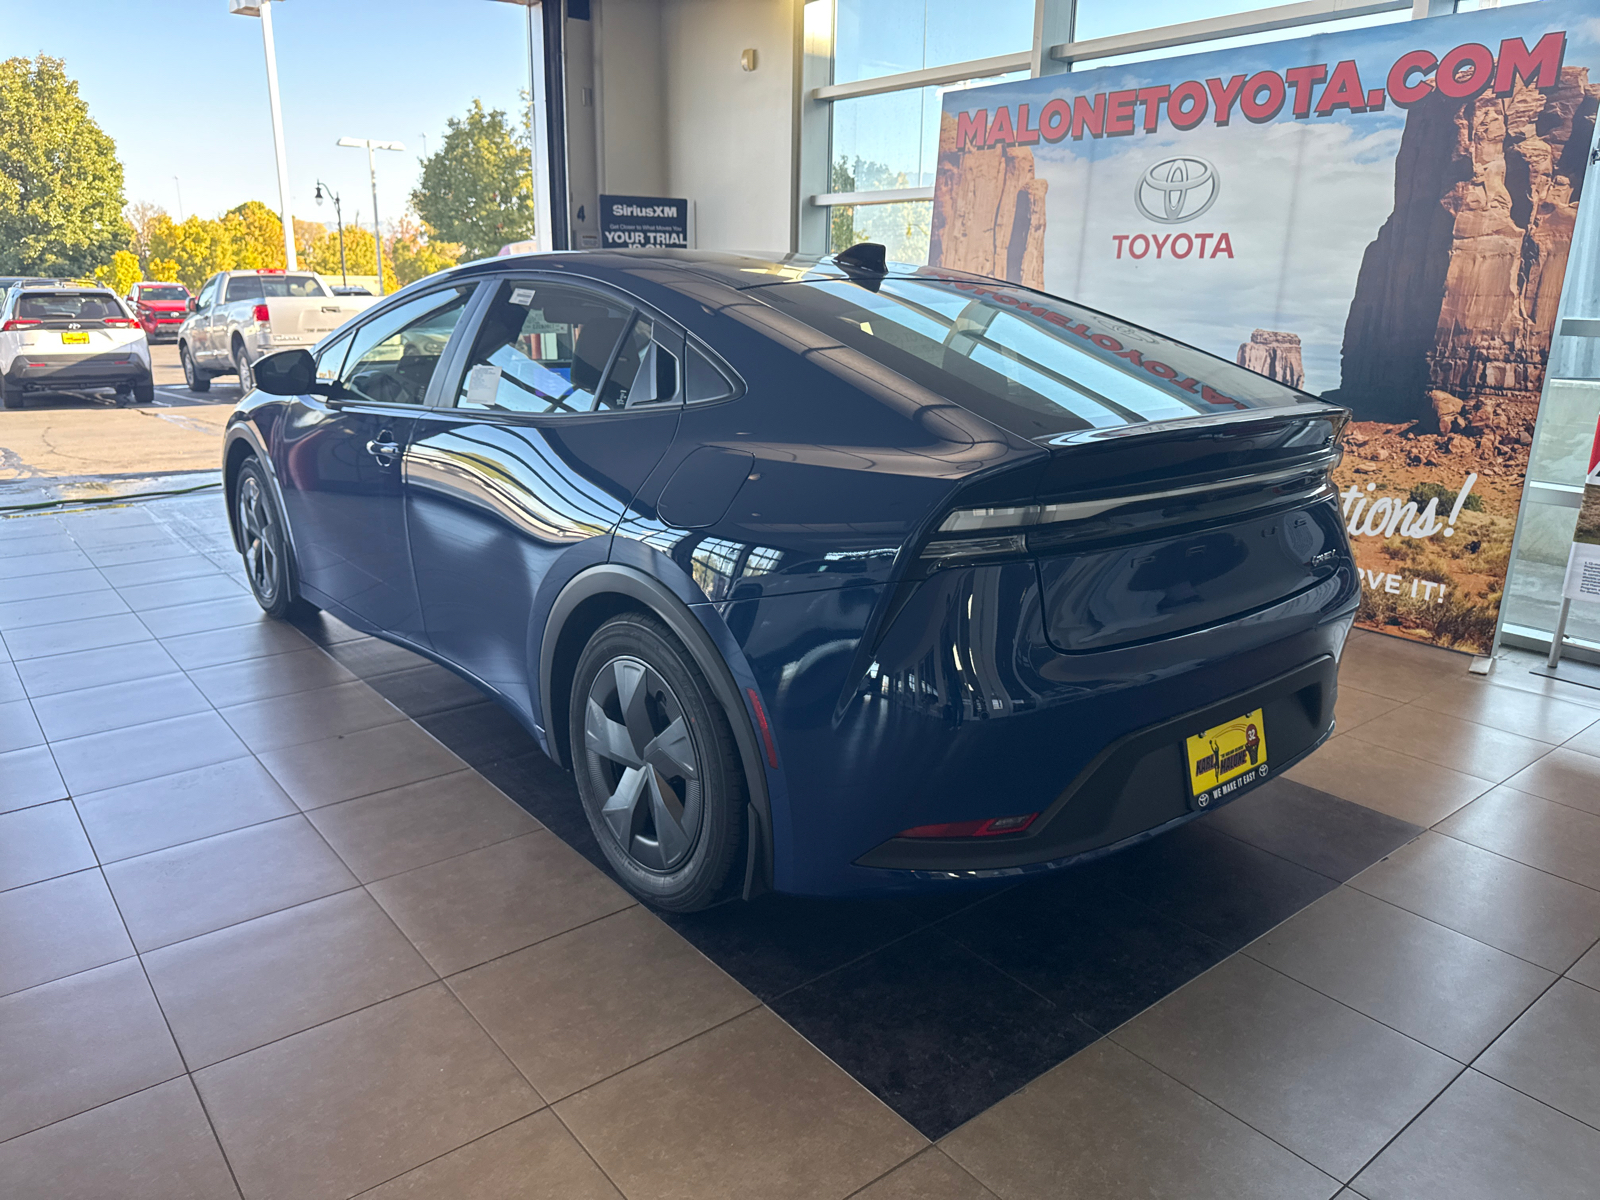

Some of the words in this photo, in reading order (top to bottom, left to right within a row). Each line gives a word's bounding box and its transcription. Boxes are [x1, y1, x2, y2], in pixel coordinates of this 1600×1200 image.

[955, 31, 1568, 151] MALONETOYOTA.COM
[612, 204, 678, 218] SiriusXM
[605, 231, 645, 244] YOUR
[646, 232, 687, 245] TRIAL
[1111, 231, 1235, 260] TOYOTA
[1411, 578, 1446, 603] IT!
[1247, 729, 1256, 741] 32
[1212, 788, 1221, 800] WE
[1222, 781, 1237, 795] MAKE
[1237, 777, 1242, 787] IT
[1243, 771, 1256, 785] EASY
